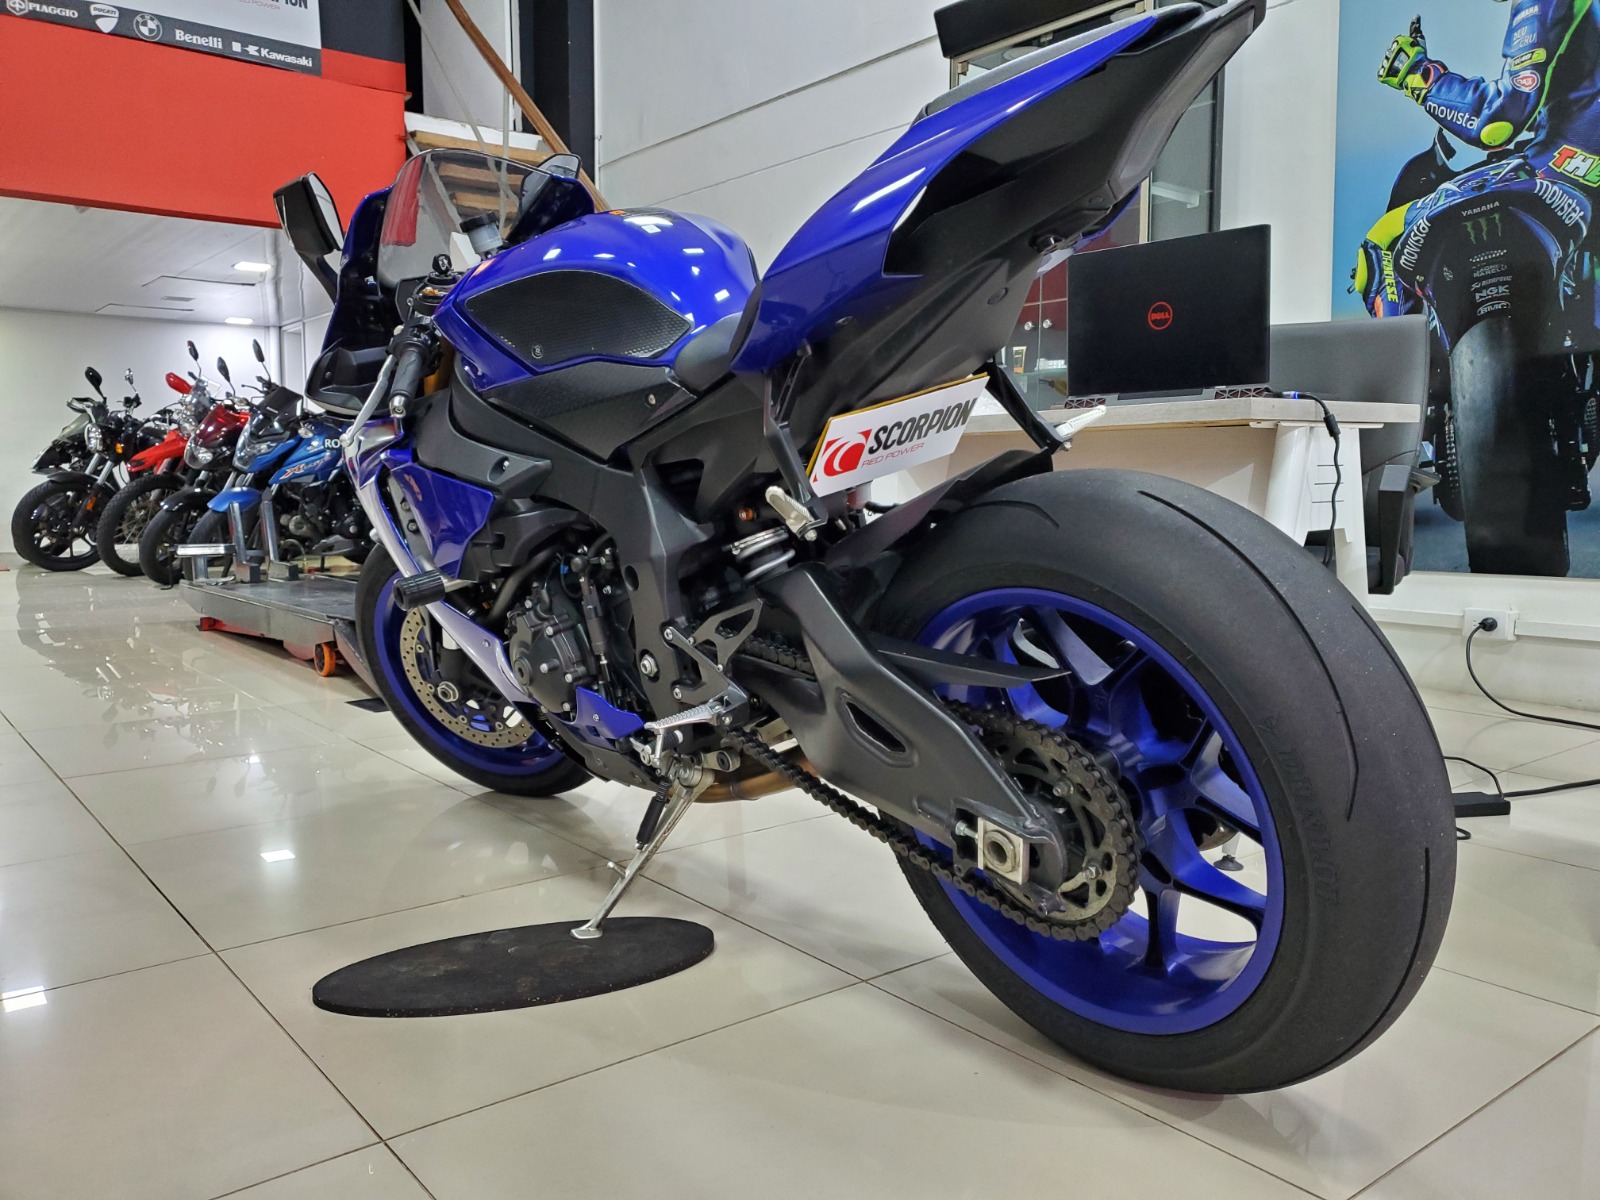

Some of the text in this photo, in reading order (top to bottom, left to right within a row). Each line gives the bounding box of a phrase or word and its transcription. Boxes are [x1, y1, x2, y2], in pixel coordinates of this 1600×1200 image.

[28, 3, 79, 18] PIAGGIO
[92, 6, 117, 15] DUCATI
[175, 29, 223, 49] Benelli
[261, 48, 313, 67] Kawasaki
[1461, 201, 1500, 217] YAMAHA
[1534, 179, 1585, 227] movistar
[1400, 215, 1431, 271] movistar
[1475, 285, 1510, 300] NGK
[1151, 312, 1170, 320] DELL
[868, 397, 978, 454] SCORPION
[861, 443, 925, 468] RED POWER
